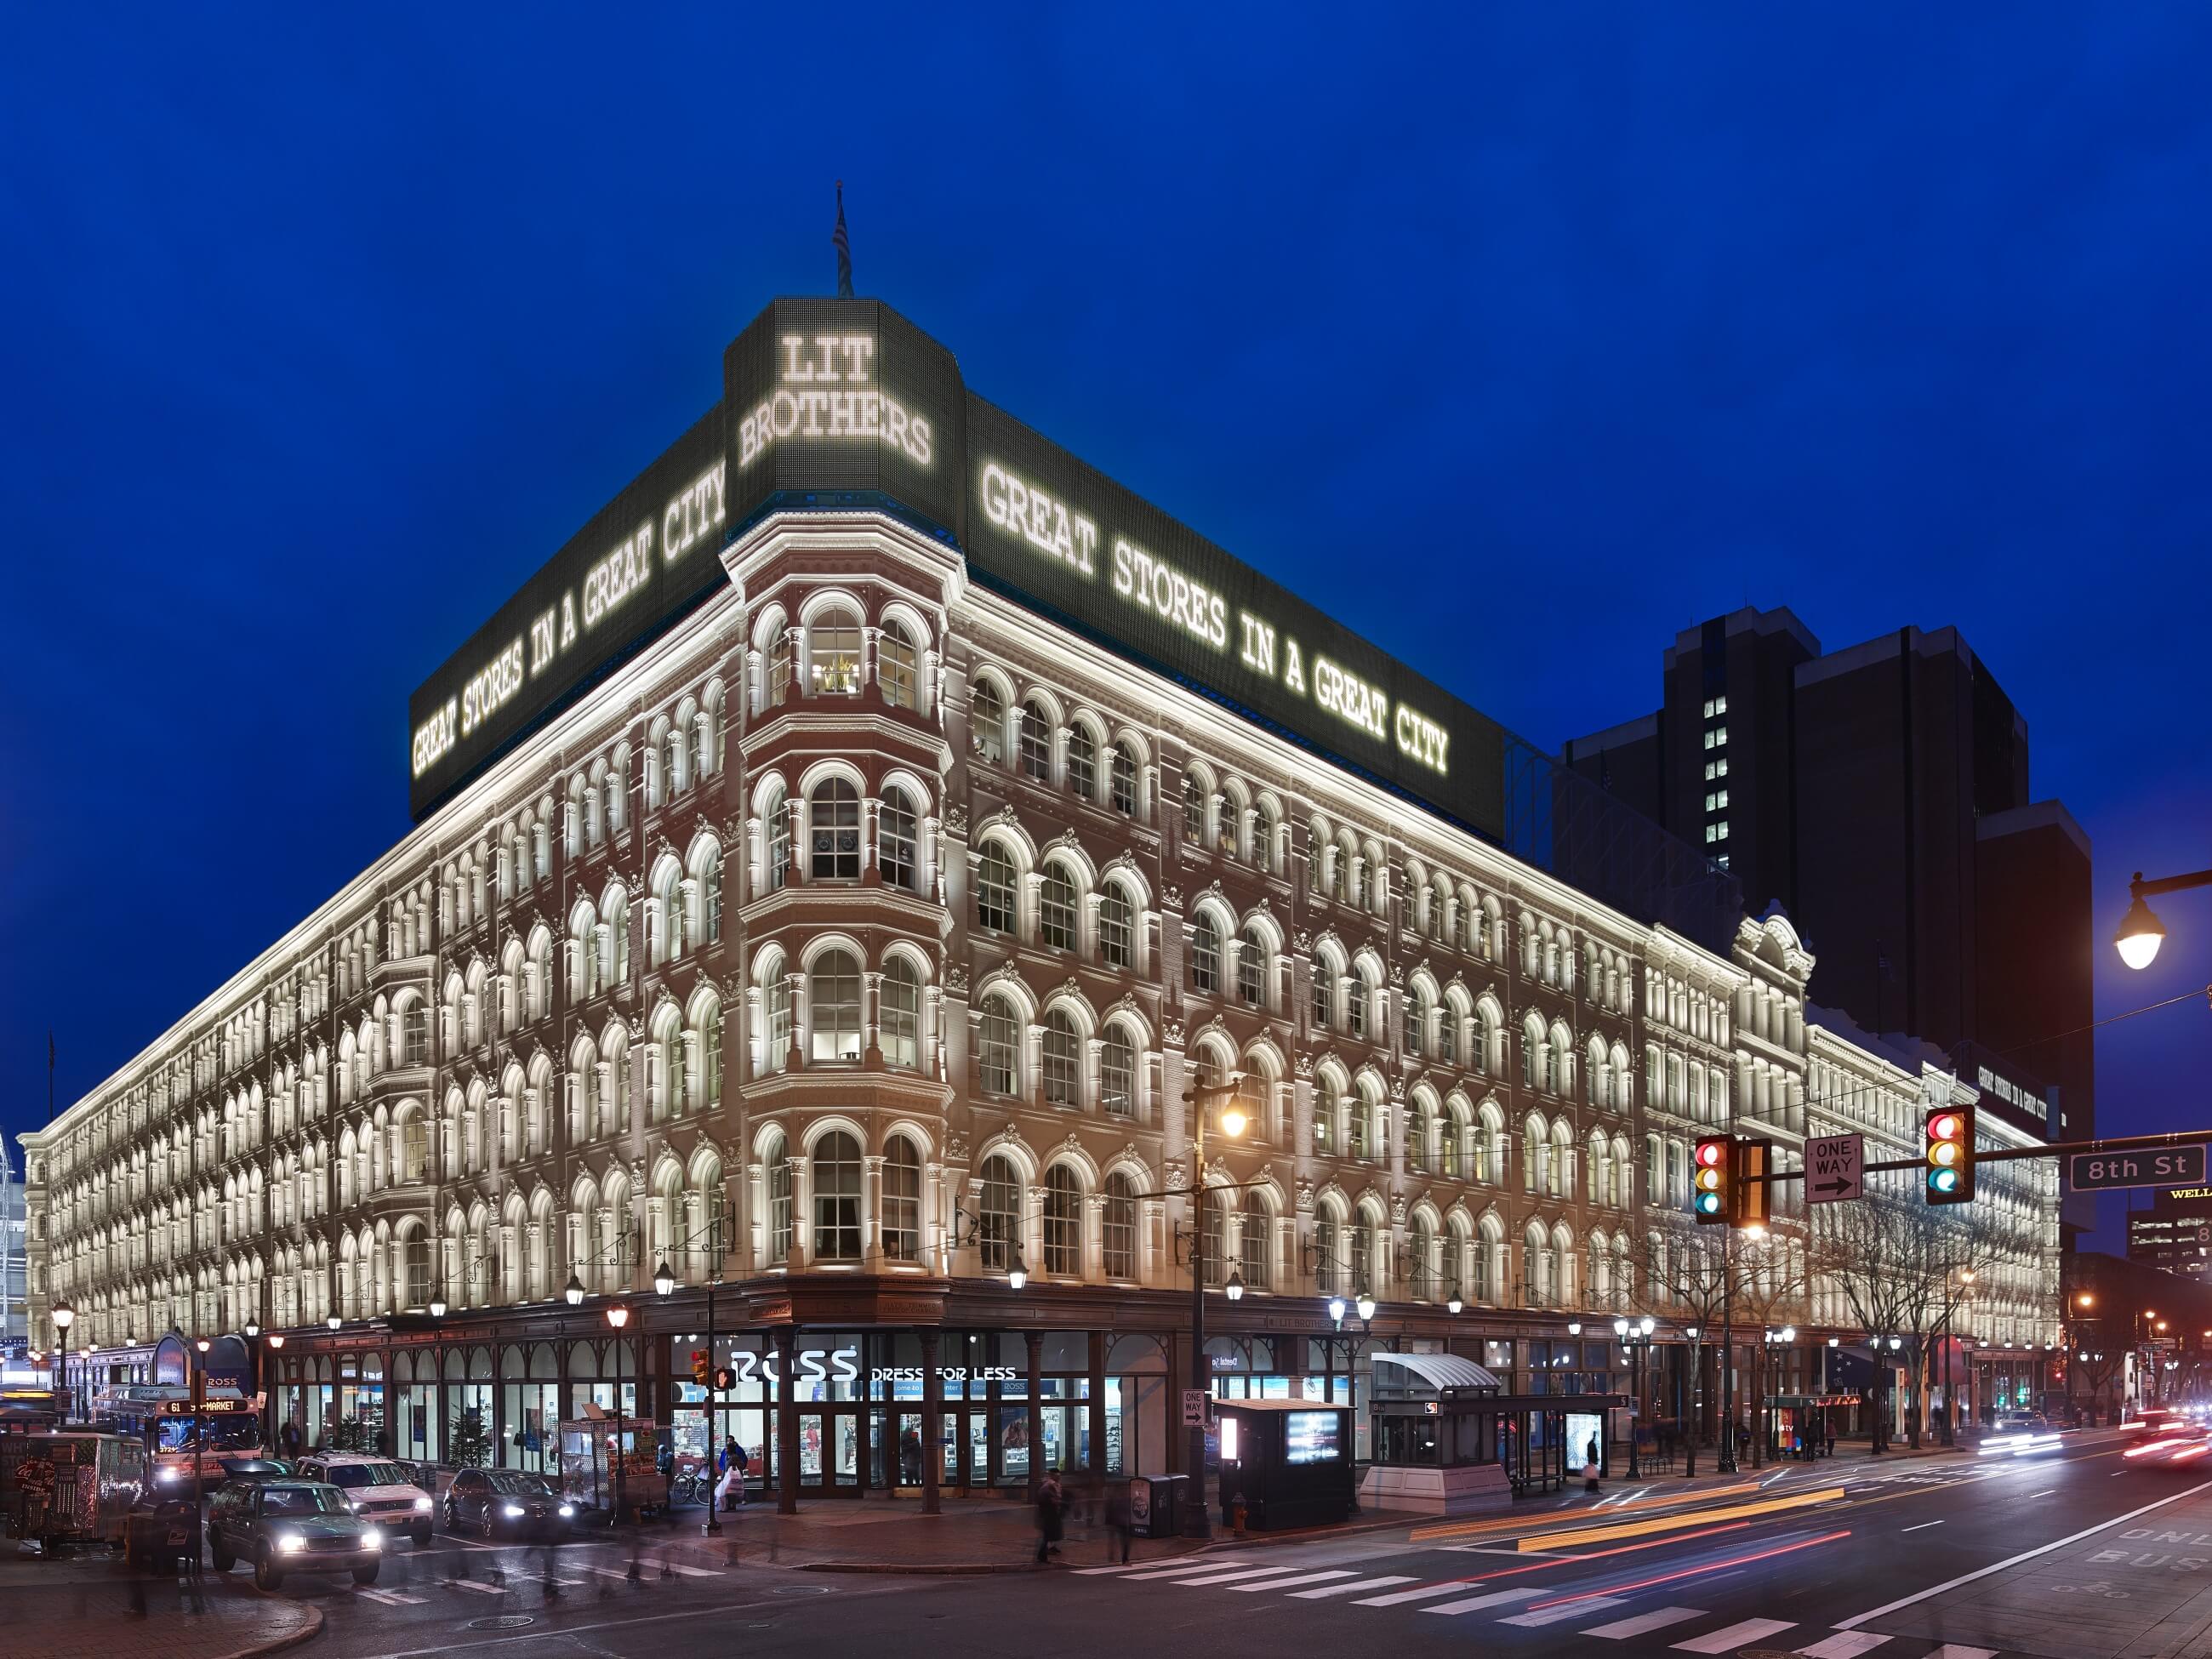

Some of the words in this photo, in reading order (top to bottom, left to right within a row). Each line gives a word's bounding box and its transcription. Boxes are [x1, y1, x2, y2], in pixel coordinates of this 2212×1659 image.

[782, 336, 874, 381] LIT
[740, 390, 932, 465] BROTHERS
[413, 699, 458, 775] GREAT
[464, 640, 523, 732] STORES
[531, 610, 554, 674] IN
[561, 592, 576, 648] A
[584, 524, 653, 625] GREAT
[663, 462, 726, 560] CITY
[983, 464, 1095, 574] GREAT
[1115, 539, 1225, 647] STORES
[1241, 613, 1274, 675] IN
[1286, 640, 1305, 693] A
[1315, 658, 1386, 738] GREAT
[1397, 706, 1448, 772] CITY
[2020, 1089, 2023, 1108] A
[2038, 1099, 2047, 1121] CITY
[1816, 1141, 1851, 1157] ONE
[1816, 1158, 1853, 1175] WAY
[2089, 1160, 2138, 1179] 8th
[2155, 1155, 2186, 1175] St
[731, 1350, 858, 1382] ROSS
[871, 1368, 924, 1381] DRESS
[935, 1367, 966, 1381] FOR
[974, 1367, 1016, 1381] LESS
[171, 1403, 181, 1412] 61
[1185, 1393, 1201, 1402] ONE
[1185, 1403, 1201, 1411] WAY
[2084, 1549, 2209, 1571] BUS
